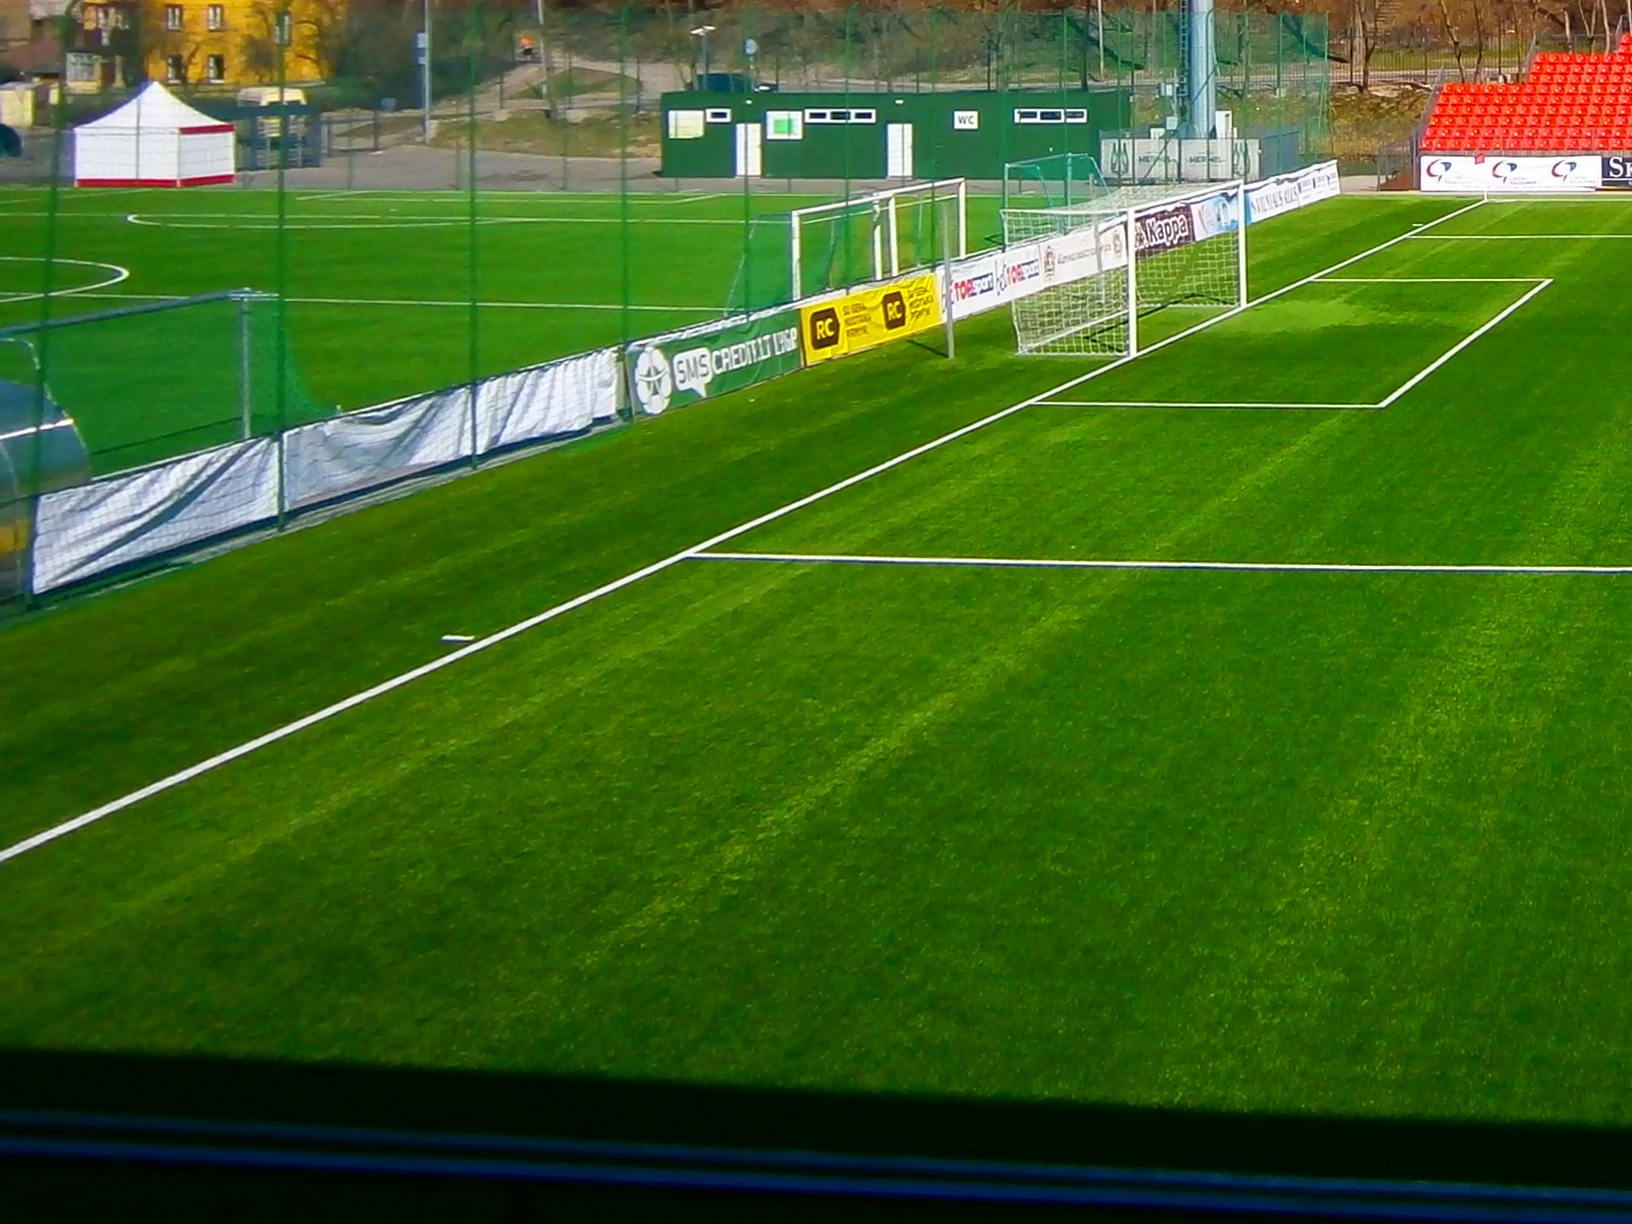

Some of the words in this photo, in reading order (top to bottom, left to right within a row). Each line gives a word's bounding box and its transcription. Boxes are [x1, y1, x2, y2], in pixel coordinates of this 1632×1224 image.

[957, 115, 975, 125] WC
[1145, 214, 1189, 247] Kappa
[887, 301, 902, 321] RC
[815, 321, 834, 341] RC
